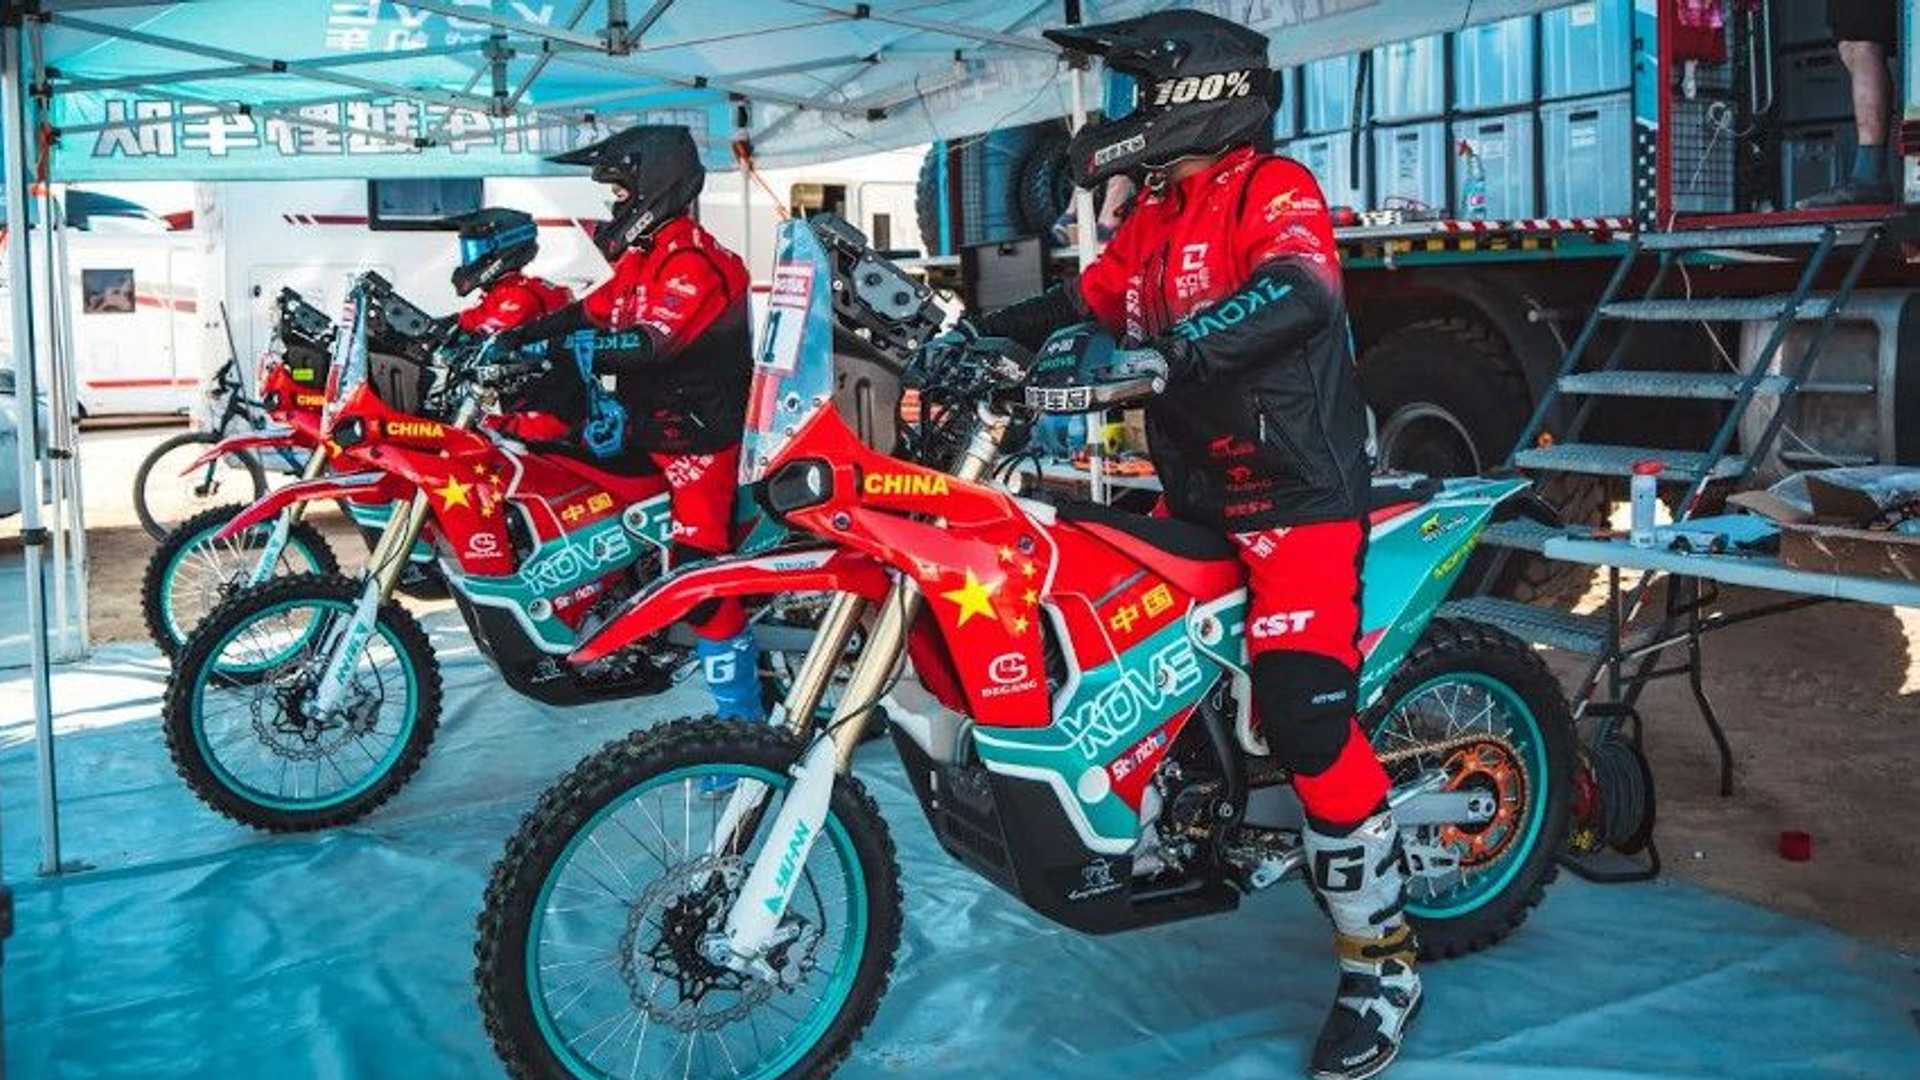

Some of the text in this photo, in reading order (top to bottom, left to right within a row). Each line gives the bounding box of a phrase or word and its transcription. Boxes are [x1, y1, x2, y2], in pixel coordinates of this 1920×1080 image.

[1154, 71, 1251, 106] 100%
[387, 422, 445, 438] CHINA
[864, 474, 950, 497] CHINA
[561, 492, 613, 521] 中国
[520, 525, 631, 595] KOVE
[1109, 583, 1175, 633] 中国
[1251, 610, 1316, 639] CST
[1058, 637, 1201, 760] KOVE
